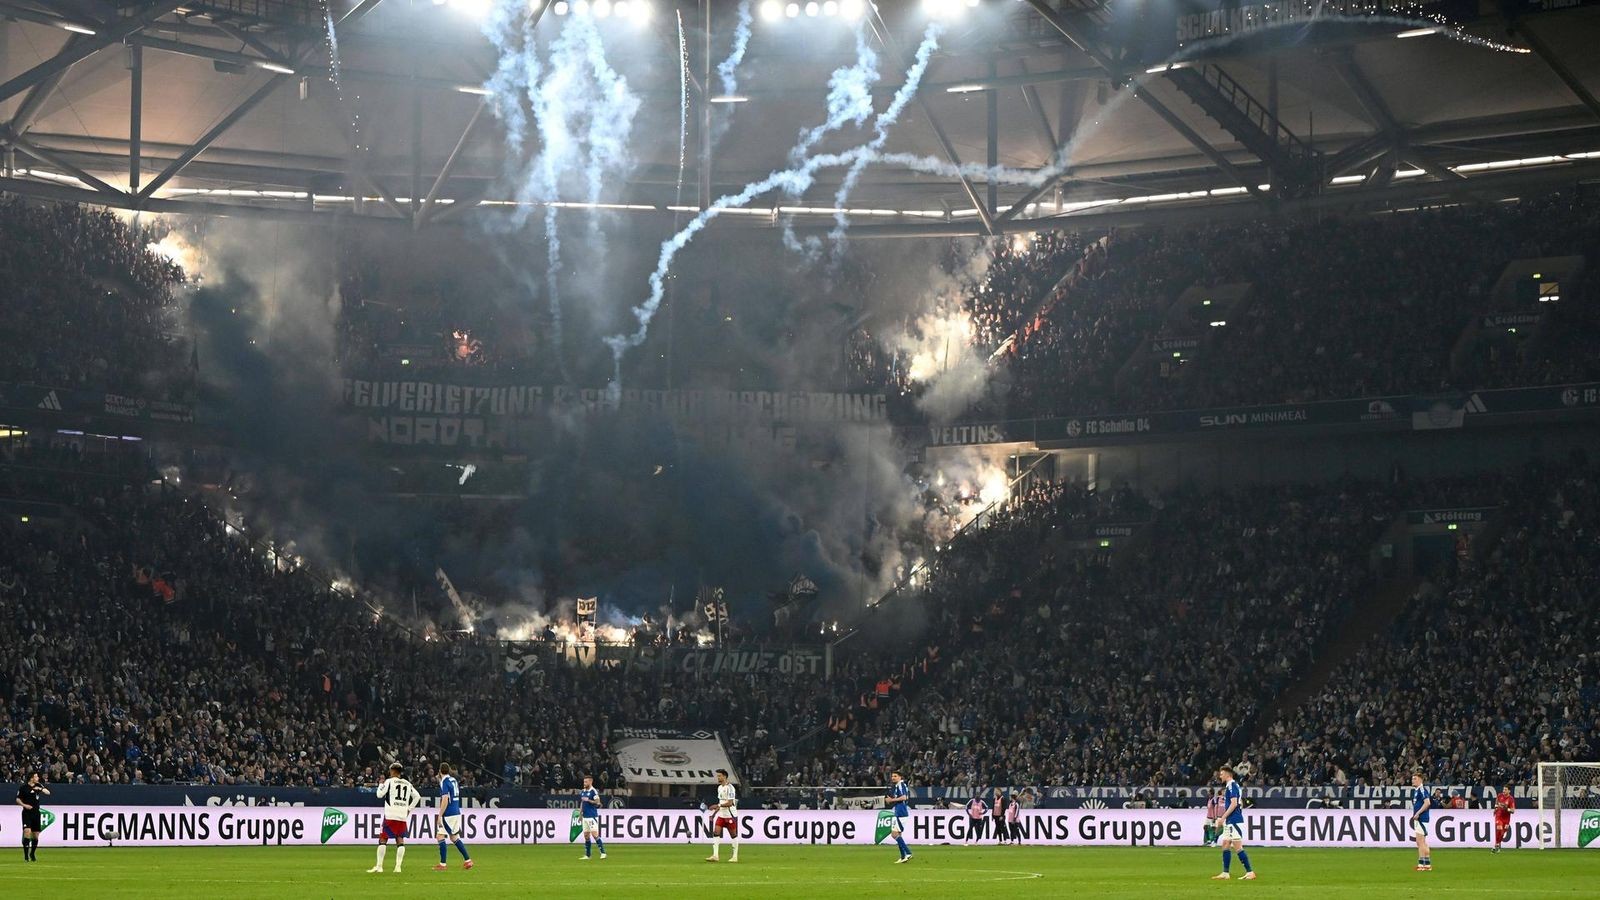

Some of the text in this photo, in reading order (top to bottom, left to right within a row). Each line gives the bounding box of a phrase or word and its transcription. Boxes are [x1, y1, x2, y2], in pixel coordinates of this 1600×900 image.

[1086, 417, 1150, 434] FC Schalke 04
[1200, 411, 1307, 427] SUN MINIMEAL
[1434, 511, 1482, 522] Stölting
[628, 767, 714, 778] VELTIN
[394, 784, 408, 802] 11
[63, 812, 304, 846] HEGMANNS Gruppe
[324, 815, 343, 826] HGH
[354, 814, 556, 844] HEMAS Gruppe
[598, 815, 856, 845] HEGMANS Gruppe
[913, 815, 1182, 846] HEGNNS Gruppe
